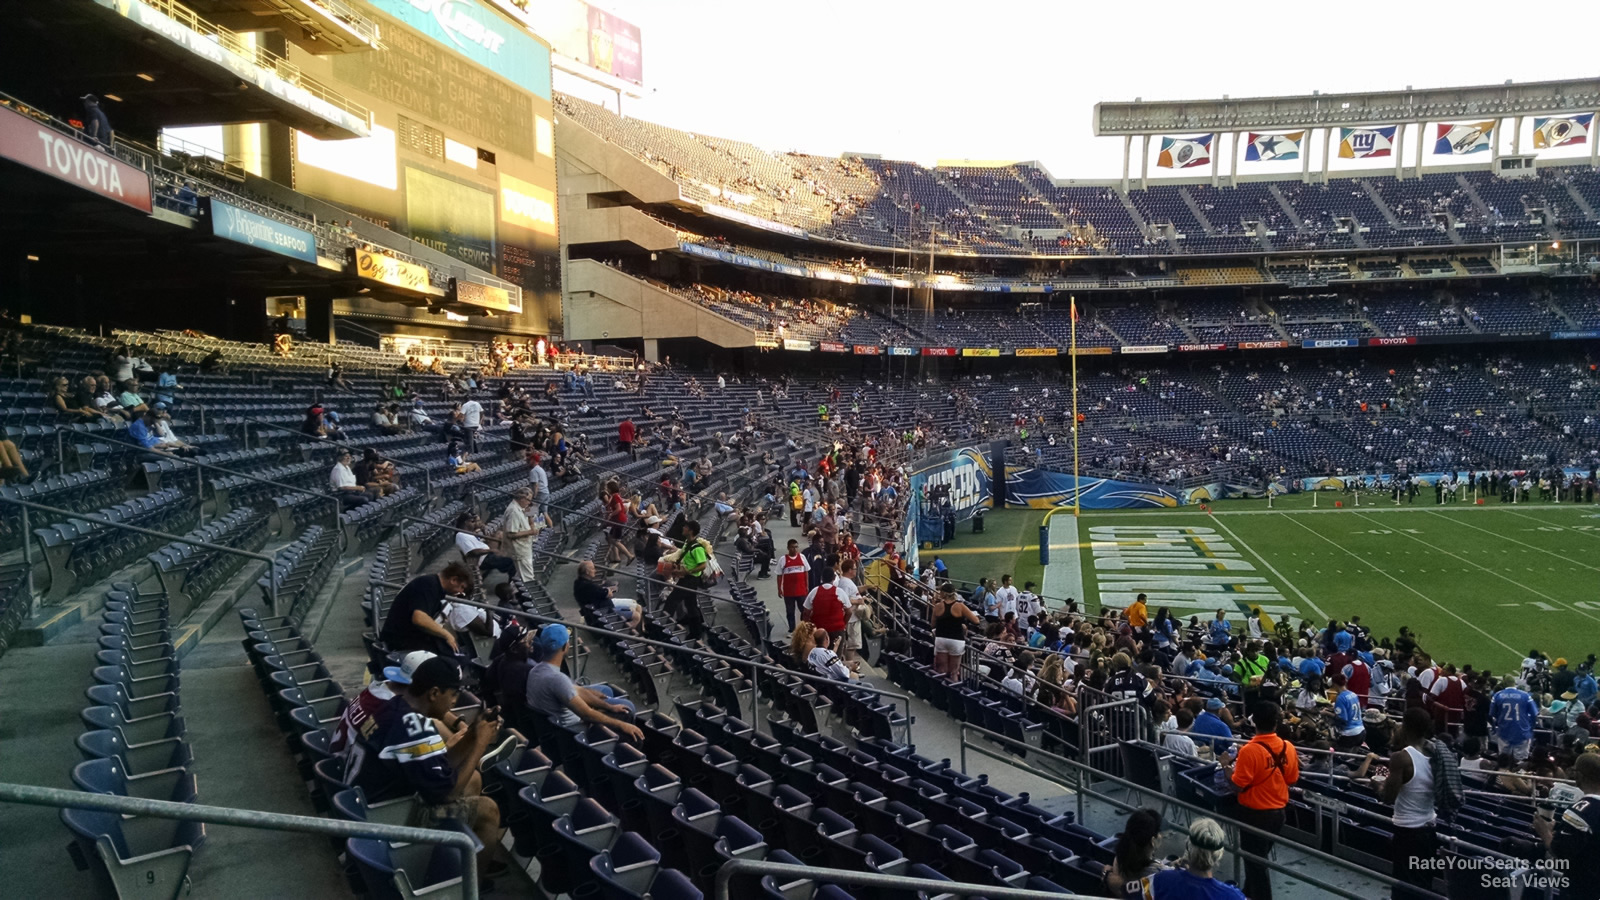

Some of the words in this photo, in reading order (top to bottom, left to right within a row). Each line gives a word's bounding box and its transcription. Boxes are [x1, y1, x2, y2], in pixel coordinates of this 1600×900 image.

[368, 70, 432, 114] ARIZONA
[449, 80, 483, 114] GAME
[38, 130, 123, 197] TOYOTA
[234, 208, 275, 244] Brigantine
[274, 231, 308, 253] SEAFOOD
[1245, 340, 1282, 349] CYMER
[1314, 338, 1348, 348] GEICO
[1379, 336, 1408, 345] TOYOTA
[893, 347, 912, 355] GEICO
[1018, 600, 1029, 614] 32
[1502, 702, 1520, 721] 21
[146, 870, 155, 884] 9
